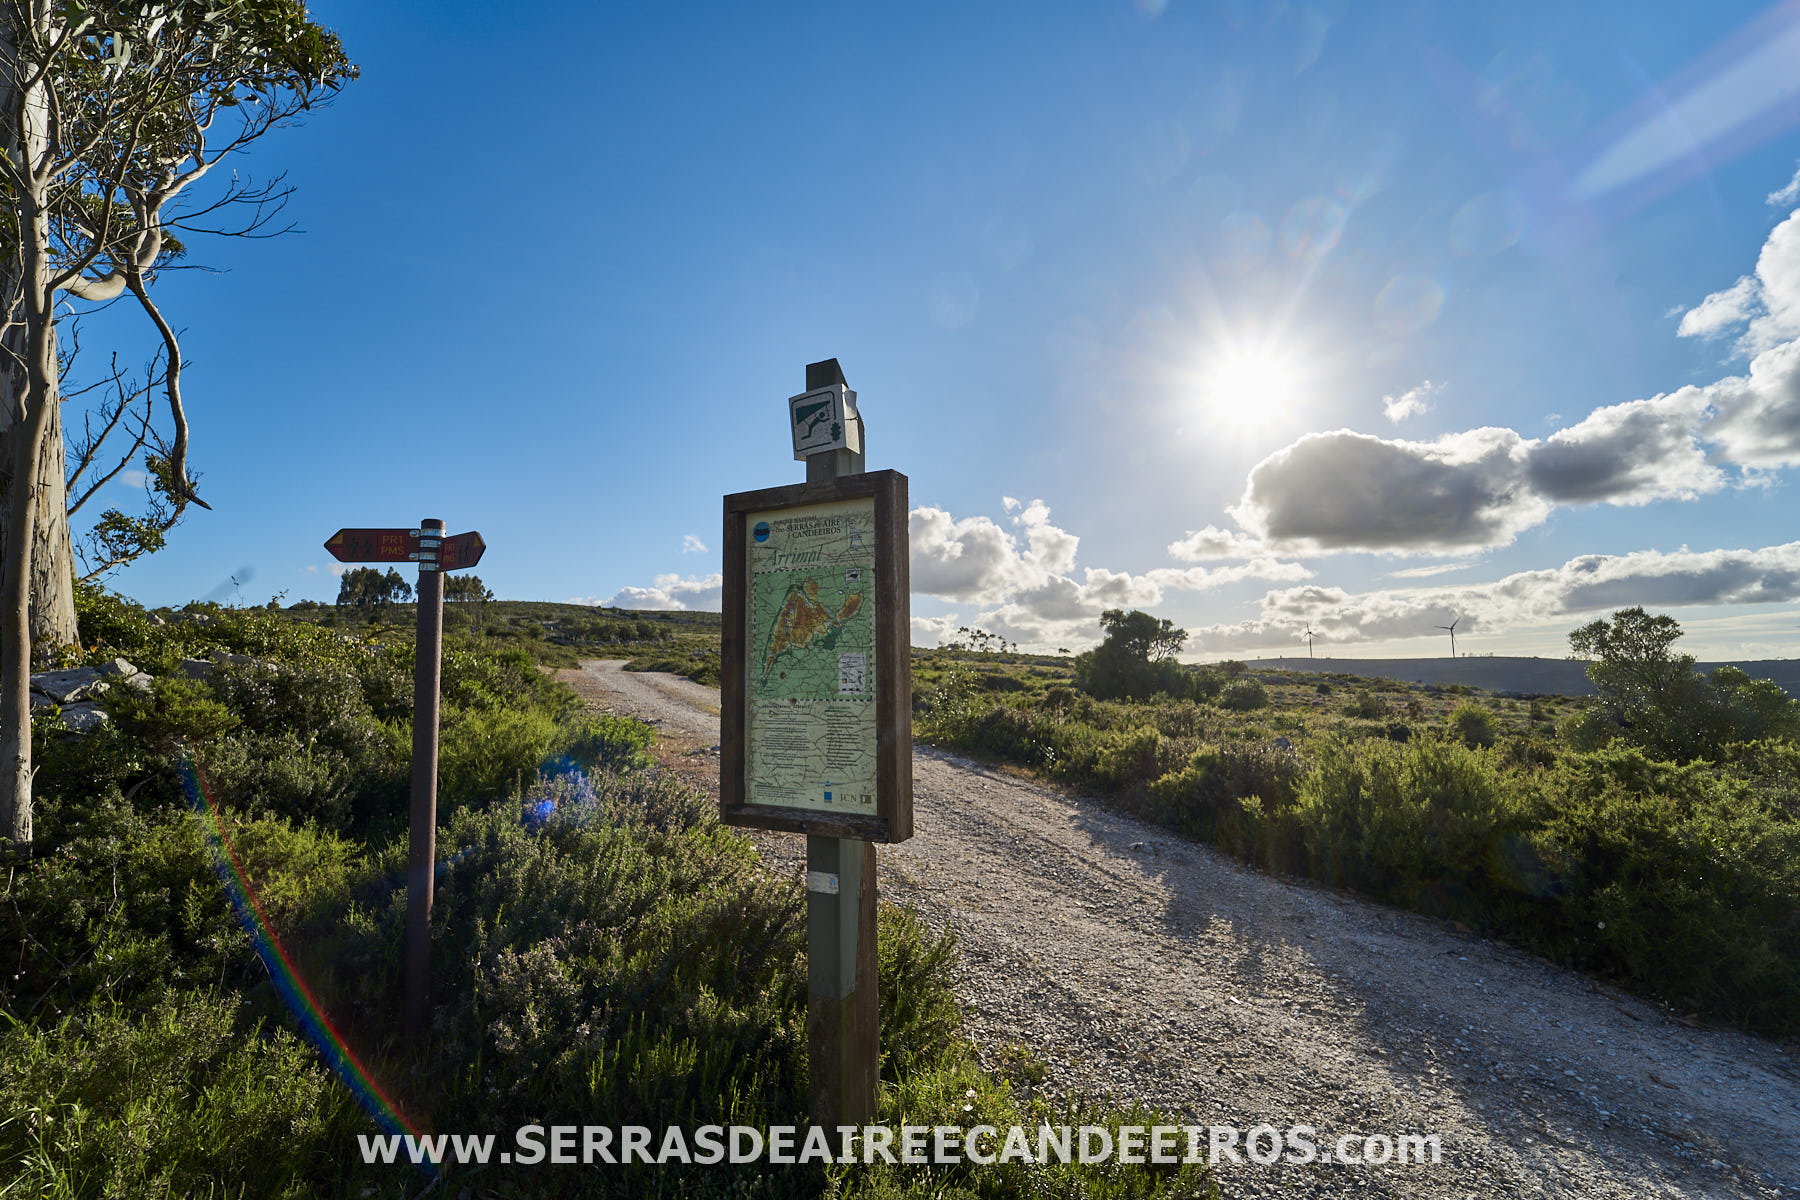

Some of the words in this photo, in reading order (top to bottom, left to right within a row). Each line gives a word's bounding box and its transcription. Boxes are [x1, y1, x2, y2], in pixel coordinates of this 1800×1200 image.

[787, 522, 813, 532] SERRAS
[824, 519, 841, 527] AIRE
[792, 527, 841, 539] CANDEEIROS
[383, 535, 402, 544] PR1
[762, 544, 823, 567] Arrimal
[840, 793, 857, 802] ICN
